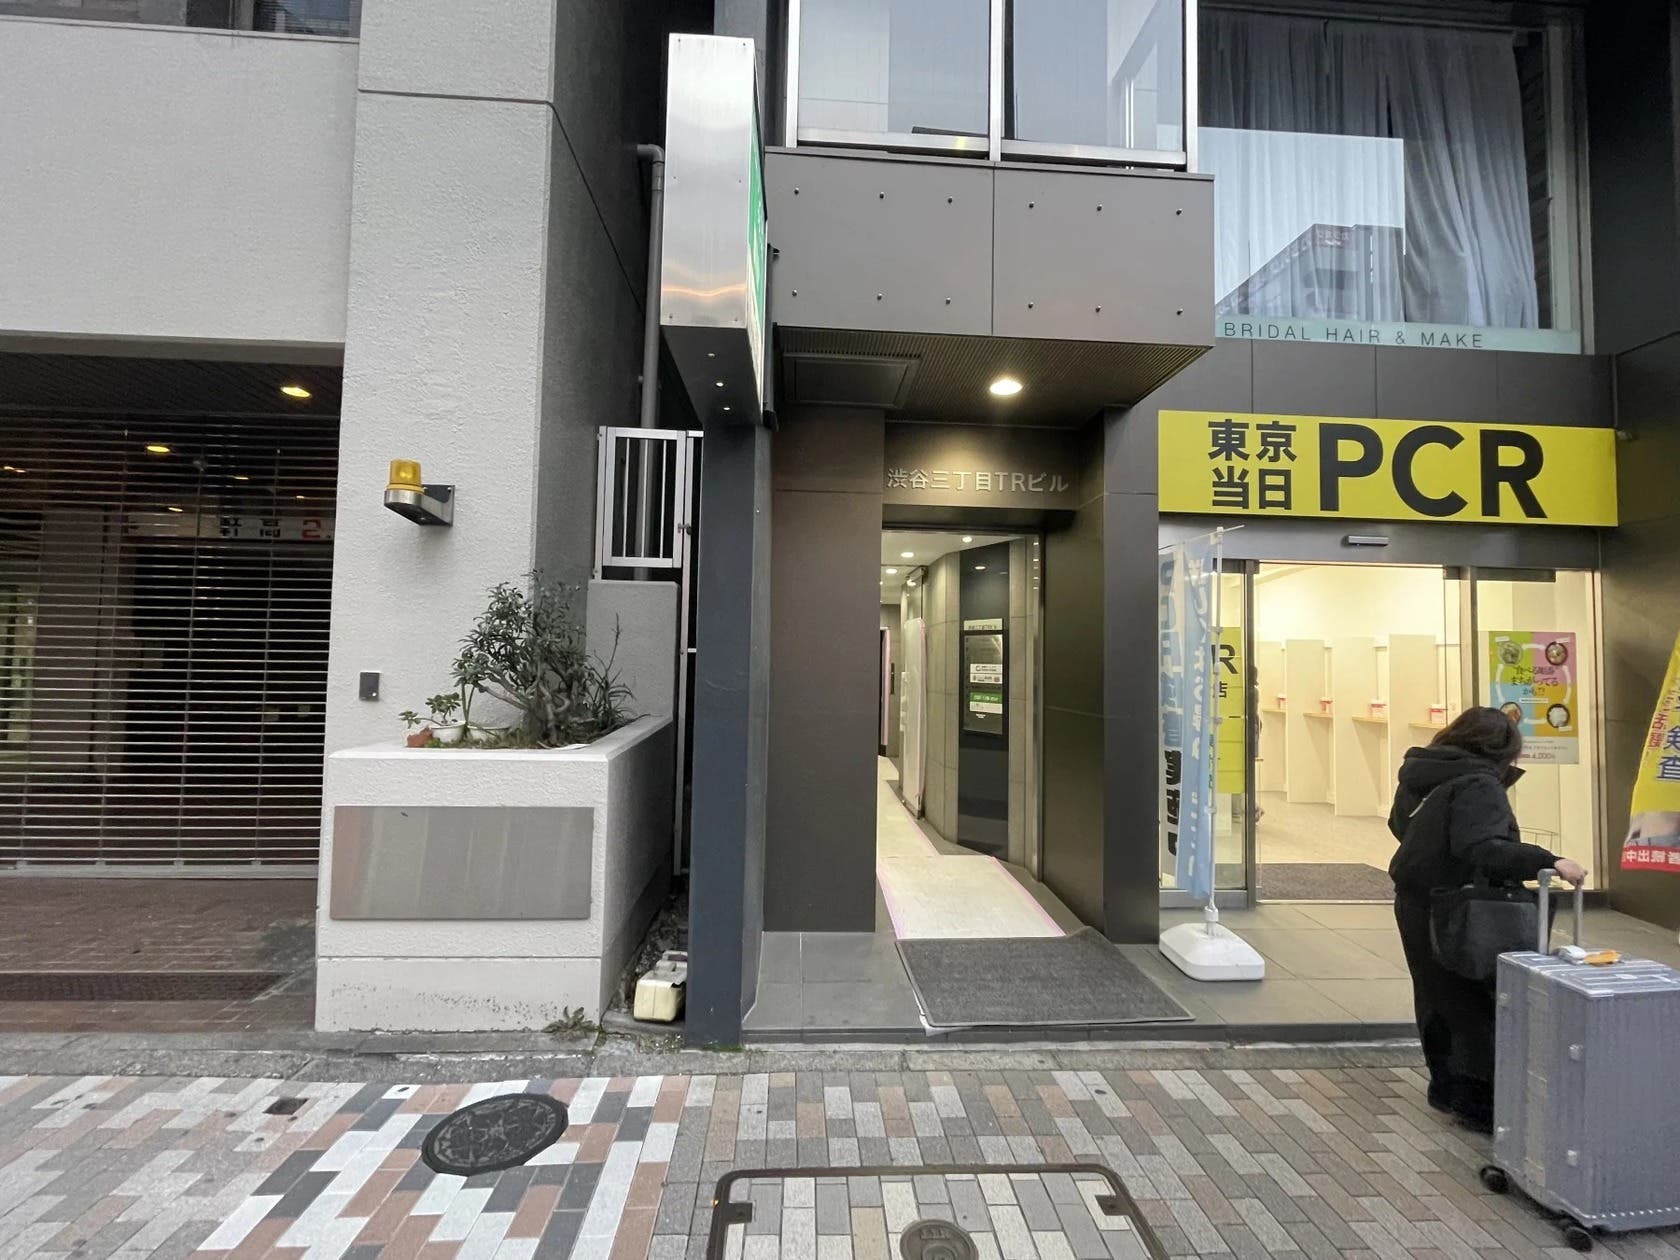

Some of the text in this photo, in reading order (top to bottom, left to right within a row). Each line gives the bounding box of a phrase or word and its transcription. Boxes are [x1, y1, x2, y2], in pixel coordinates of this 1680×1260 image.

[1223, 321, 1484, 349] BRIDAL HAIR & MAKE
[1208, 419, 1297, 463] 東京
[887, 468, 1069, 494] 渋谷三丁目TRビル
[1211, 466, 1292, 511] 当日
[1318, 422, 1547, 519] PCR
